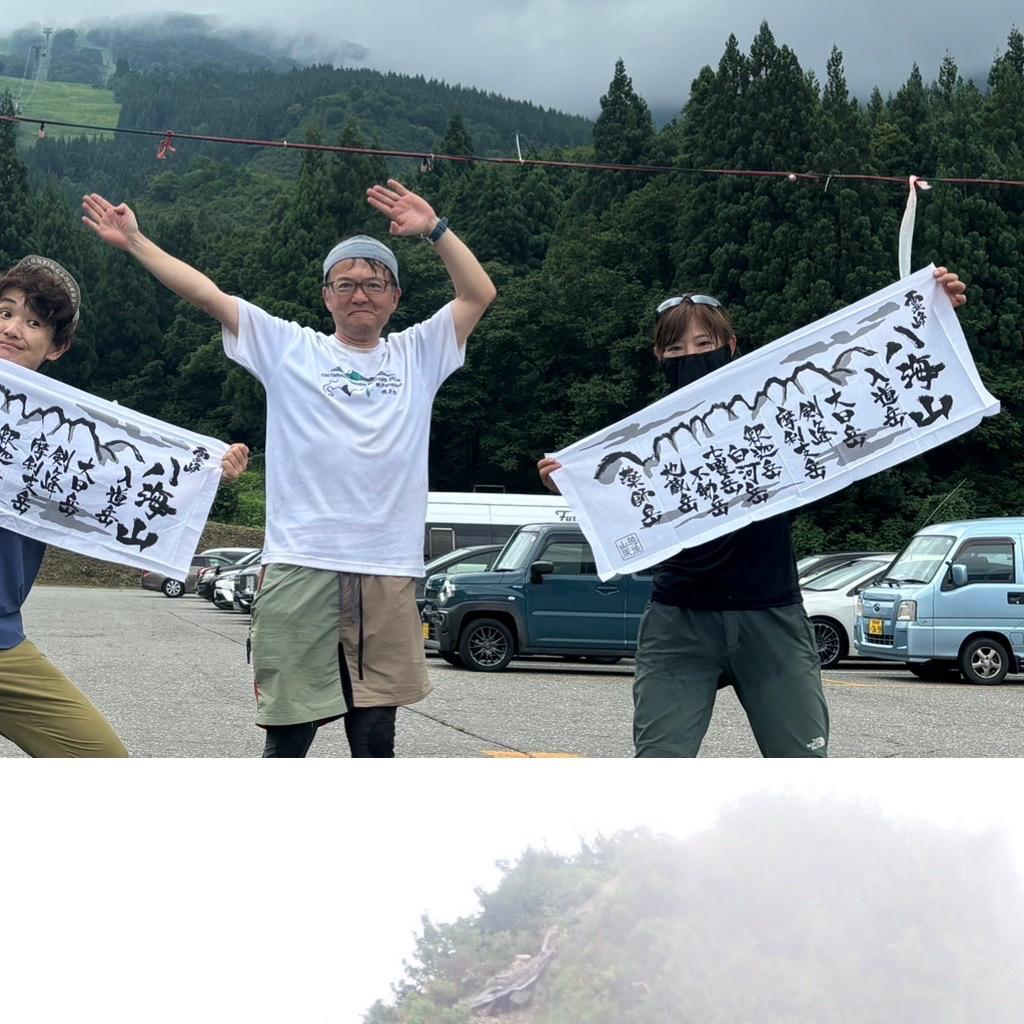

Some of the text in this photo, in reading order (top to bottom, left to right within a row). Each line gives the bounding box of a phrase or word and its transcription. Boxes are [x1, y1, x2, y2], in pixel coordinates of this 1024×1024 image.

[864, 367, 907, 427] 入道岳
[886, 325, 953, 427] 八海山
[776, 406, 826, 479] 摩利支岳
[825, 388, 867, 448] 大日岳
[11, 432, 49, 516] 摩利支岳
[58, 457, 95, 518] 大日岳
[95, 466, 132, 528] 入道岳
[116, 456, 180, 553] 八海山
[619, 466, 662, 528] 薬師岳
[660, 457, 698, 514] 地蔵岳
[689, 466, 728, 517] 不動岳
[728, 444, 769, 505] 白河岳
